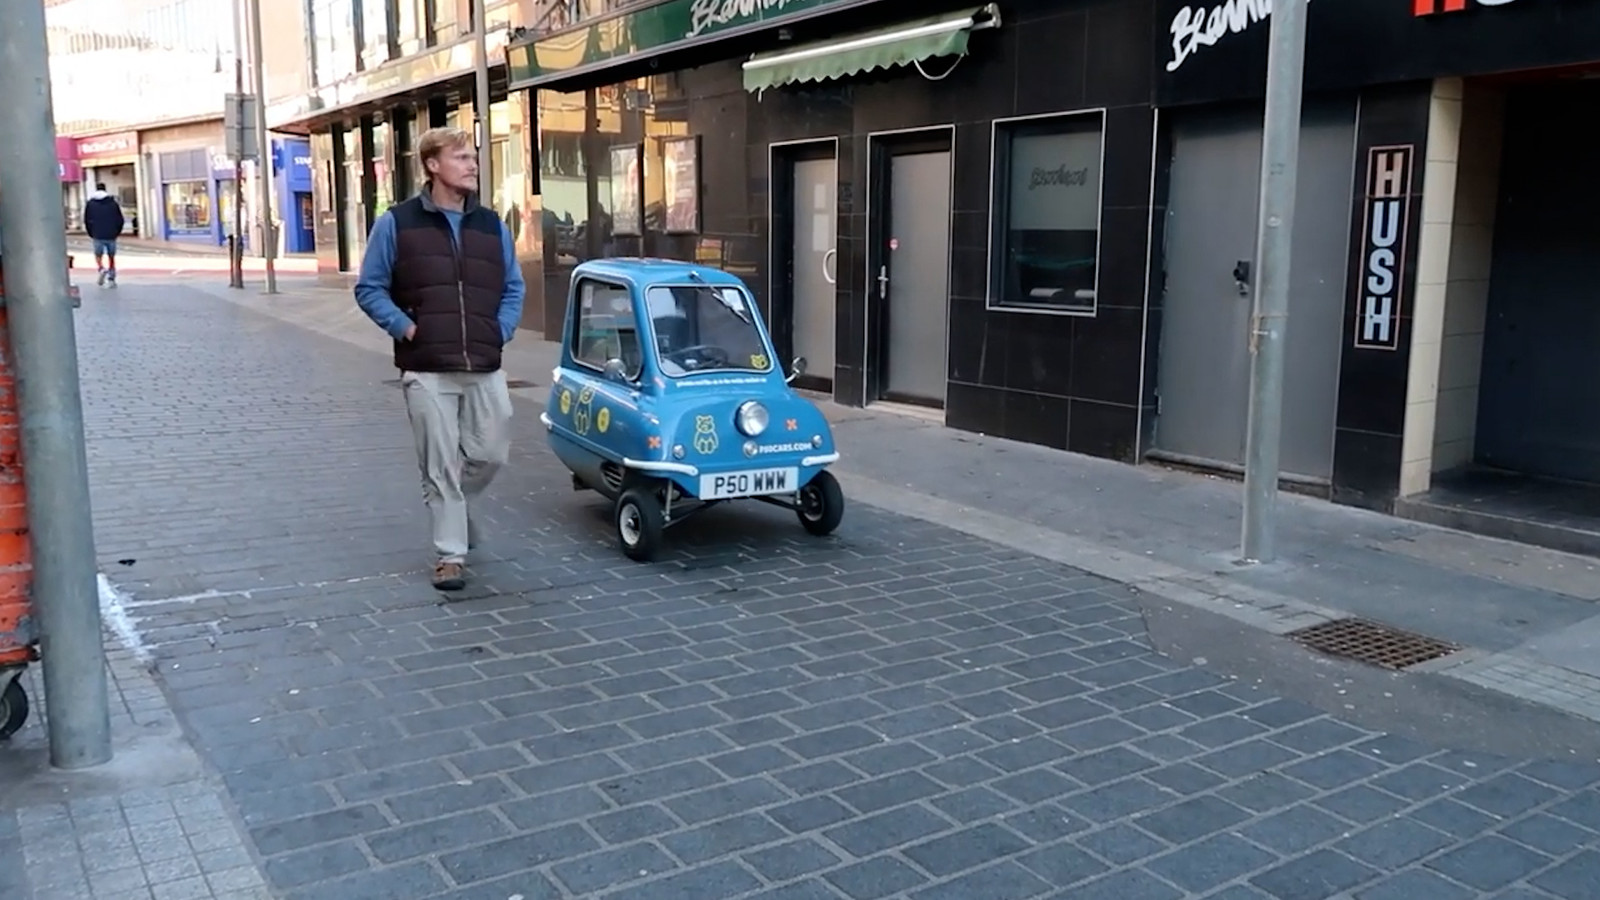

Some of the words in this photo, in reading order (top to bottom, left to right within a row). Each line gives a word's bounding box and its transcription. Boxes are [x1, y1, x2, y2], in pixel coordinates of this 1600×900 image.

[1363, 152, 1405, 342] HUSH
[759, 442, 812, 454] P50CARS.COM
[714, 474, 748, 496] P50
[753, 470, 787, 492] WWW
